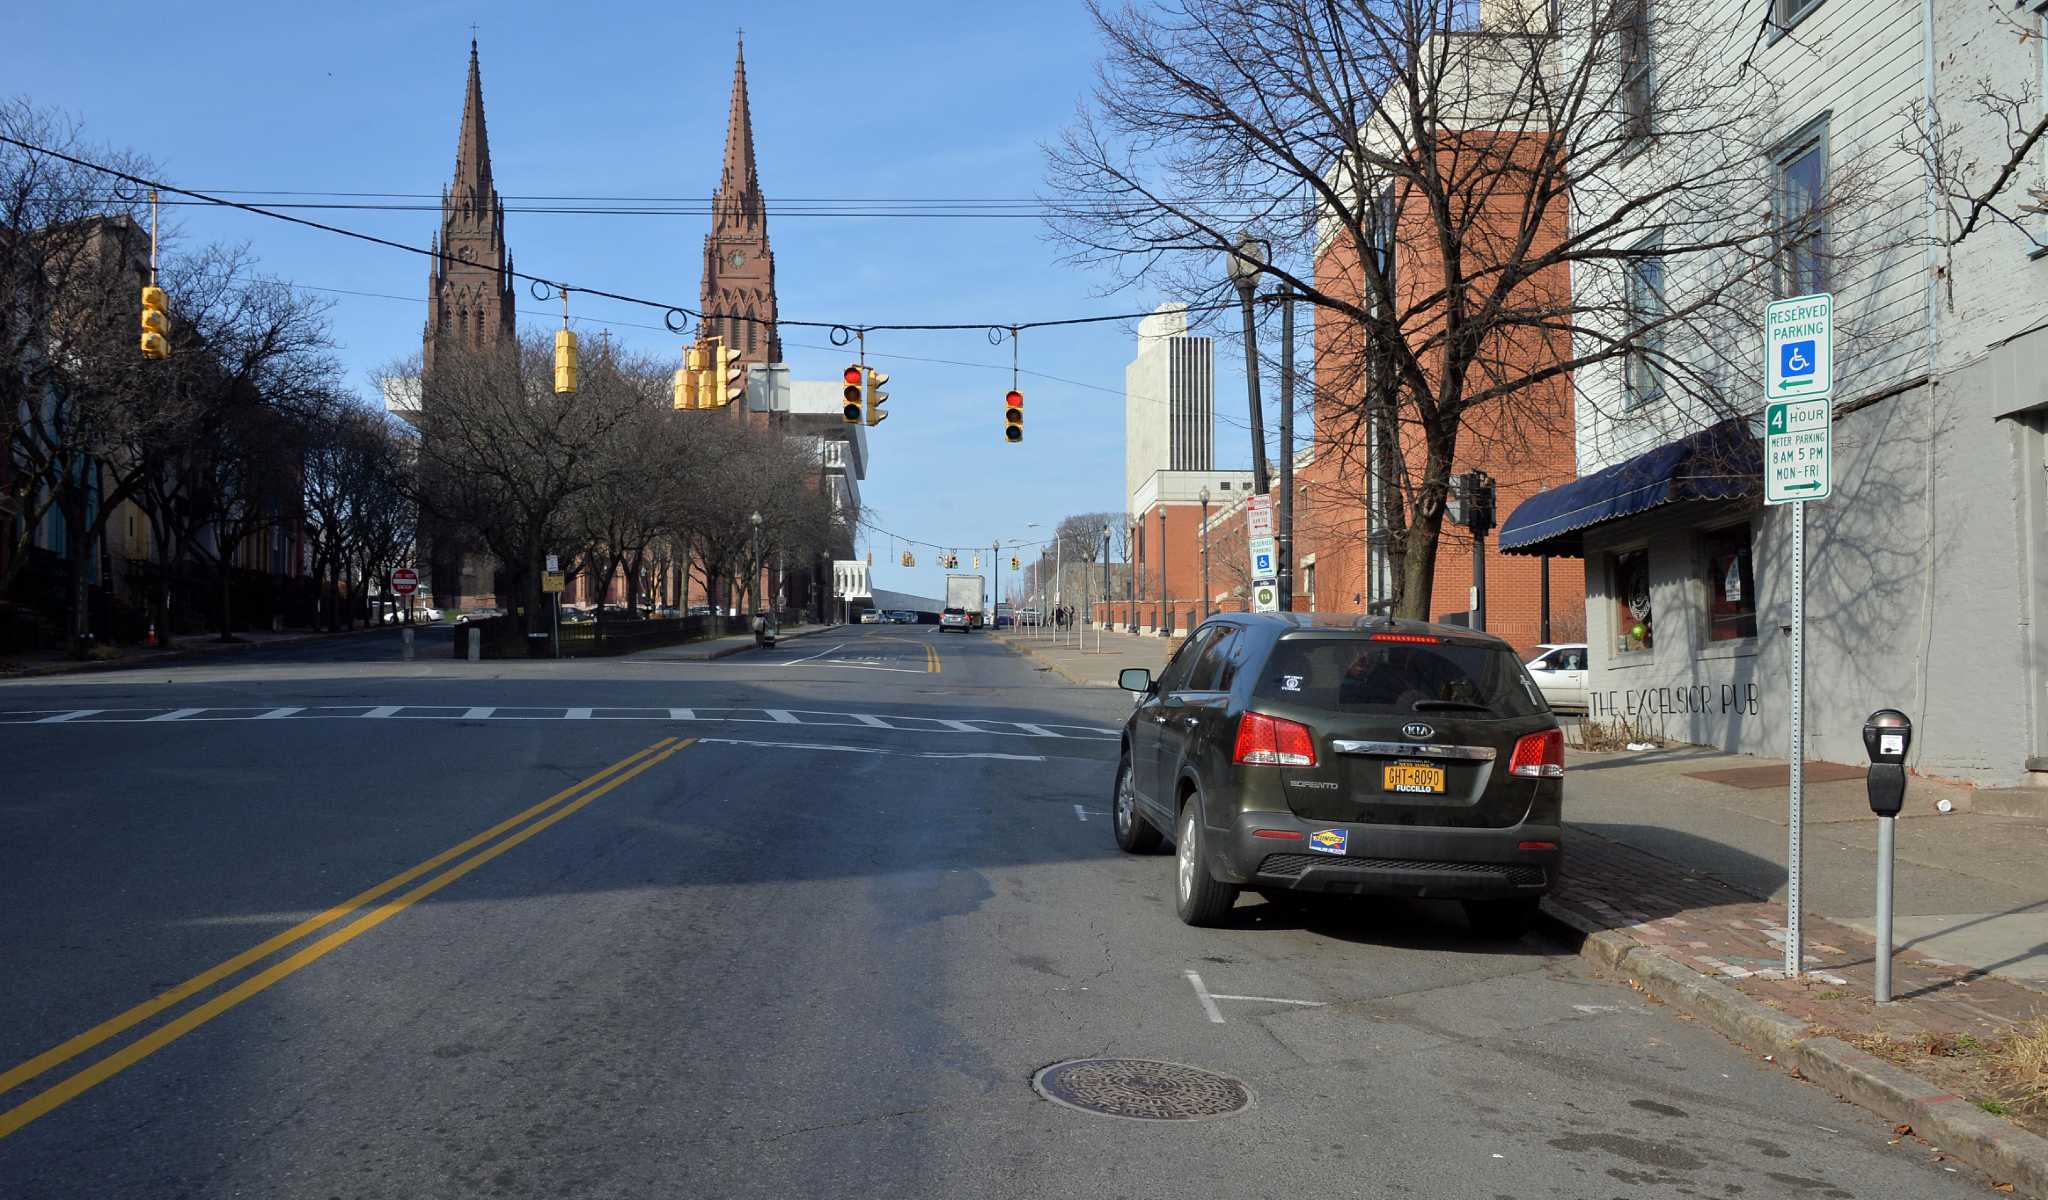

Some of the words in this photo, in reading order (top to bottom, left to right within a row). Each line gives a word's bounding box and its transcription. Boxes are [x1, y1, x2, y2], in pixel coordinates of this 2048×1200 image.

[1770, 303, 1828, 325] RESERVED
[1774, 322, 1824, 341] PARKING
[1771, 410, 1783, 429] 4
[1790, 409, 1824, 423] HOUR
[1771, 436, 1792, 448] METER
[1795, 433, 1825, 445] PARKING
[1798, 447, 1806, 461] 5
[1590, 691, 1617, 717] THE
[1626, 685, 1712, 716] EXCELSIOR
[1721, 683, 1759, 716] PUB
[1407, 726, 1428, 735] KIA
[1396, 784, 1432, 793] FUCCILLO
